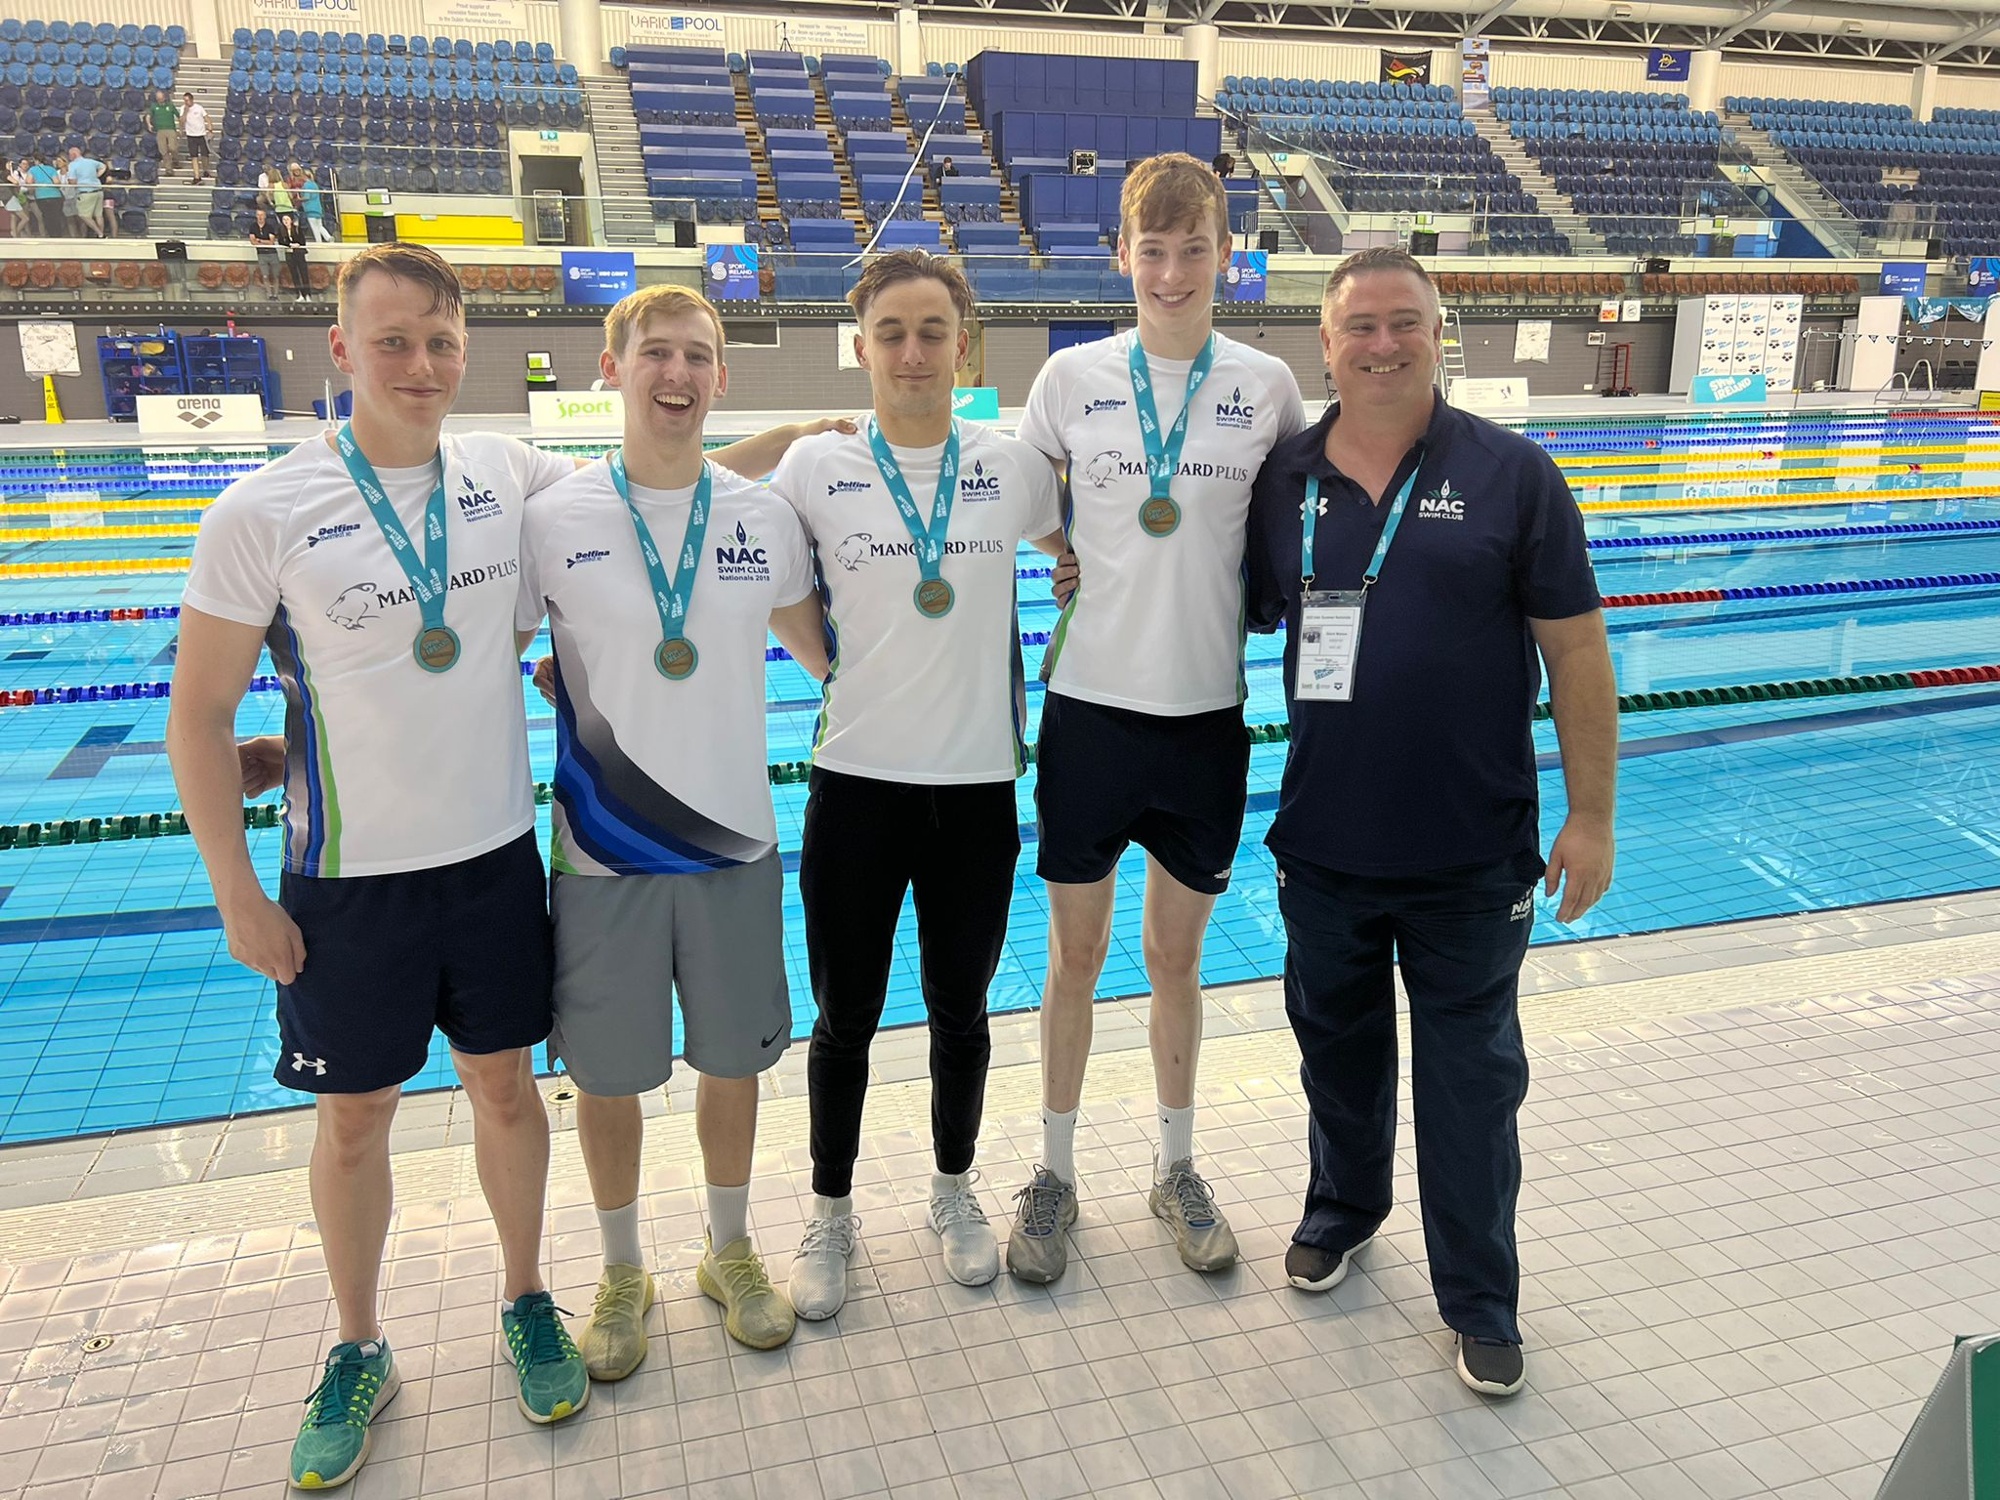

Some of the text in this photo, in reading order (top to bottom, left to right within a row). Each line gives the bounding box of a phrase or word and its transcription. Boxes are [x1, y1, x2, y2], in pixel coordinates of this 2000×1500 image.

[631, 15, 723, 31] VARIO POOL
[1713, 377, 1752, 402] IRELAND
[177, 398, 221, 410] arena
[1216, 403, 1254, 418] NAC
[1236, 417, 1253, 425] CLUB
[1215, 465, 1249, 482] PLUS
[837, 480, 871, 488] Delfina
[960, 477, 999, 490] NAC
[457, 489, 496, 510] NAC
[463, 503, 501, 517] SWIM CLUB
[1419, 499, 1466, 514] NAC
[1442, 512, 1464, 521] CLUB
[318, 523, 361, 536] Delfina
[969, 540, 1004, 553] PLUS
[575, 550, 610, 559] Delfina
[716, 547, 767, 565] NAC
[486, 558, 519, 580] PLUS
[717, 566, 770, 574] SWIM CLUB
